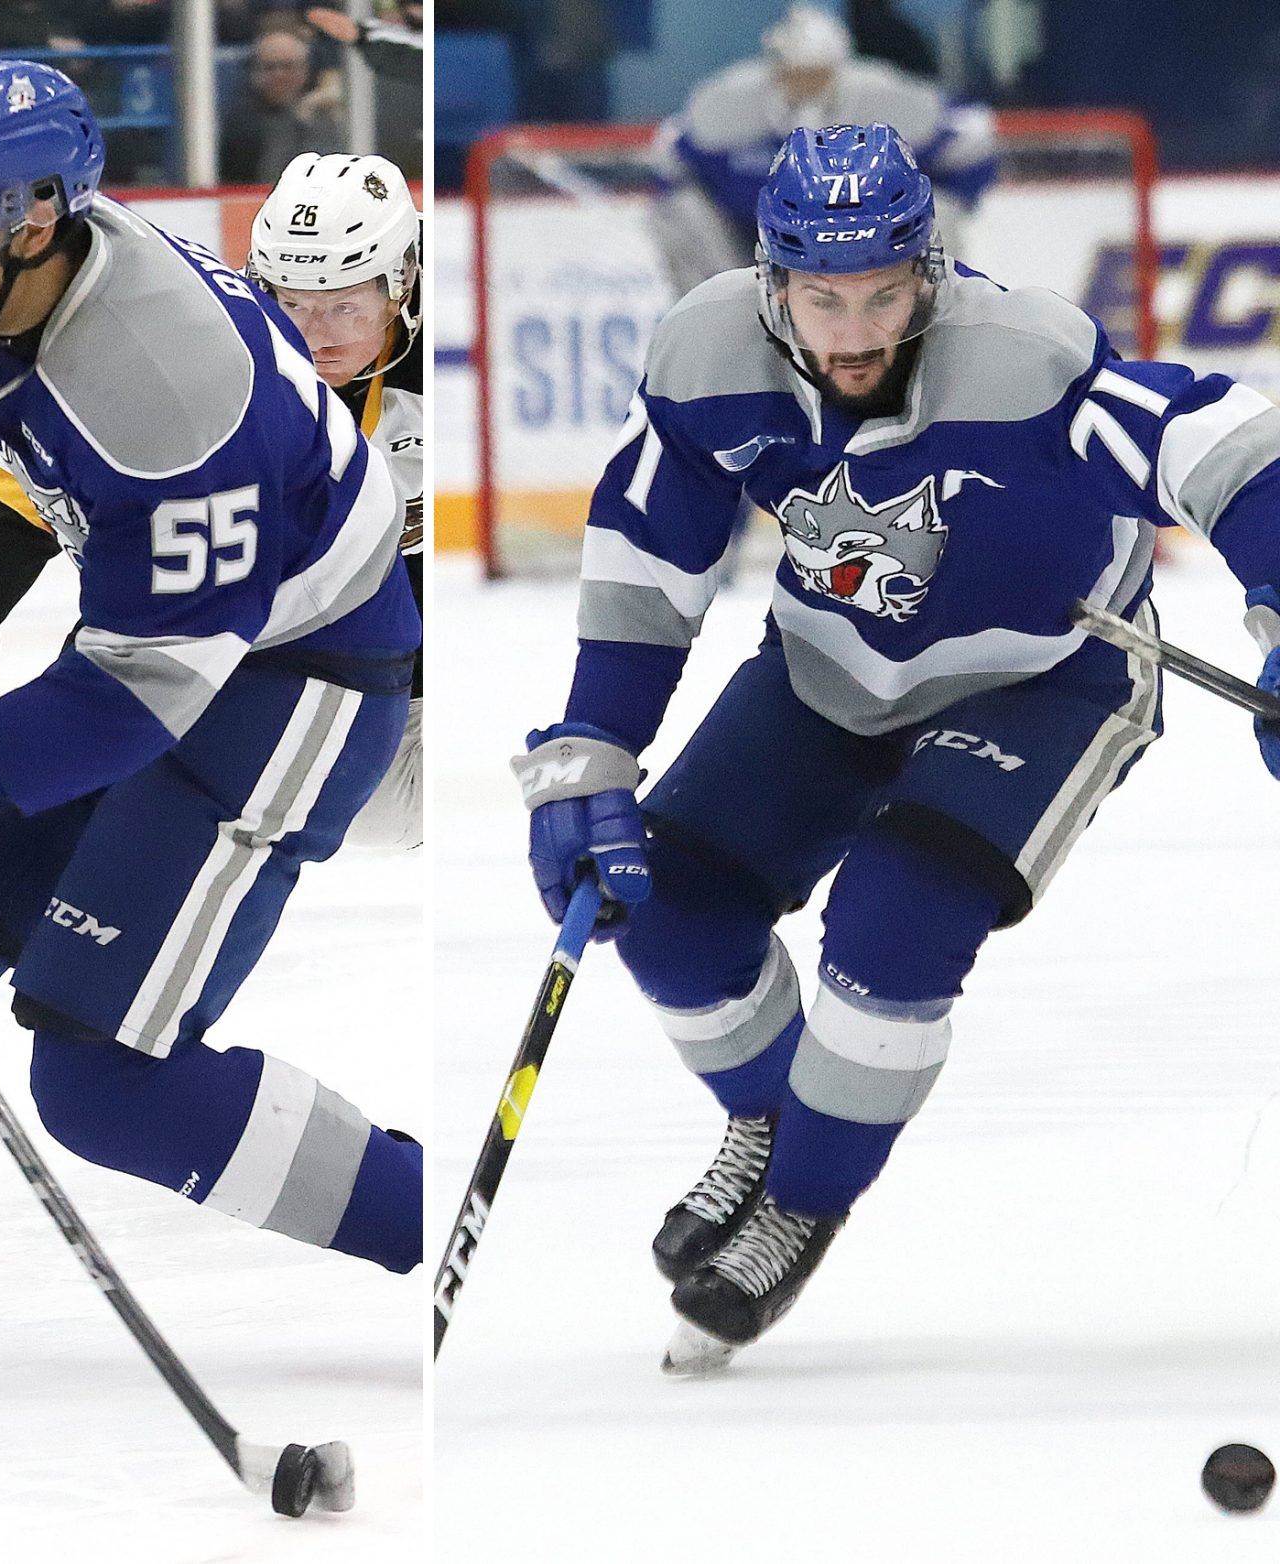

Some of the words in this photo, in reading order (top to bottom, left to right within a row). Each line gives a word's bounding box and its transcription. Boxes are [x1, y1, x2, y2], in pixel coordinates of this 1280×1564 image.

[821, 173, 861, 205] 71
[290, 204, 319, 227] 26
[815, 228, 877, 243] CCM
[279, 253, 328, 265] CCM
[1070, 367, 1172, 491] 71
[150, 483, 260, 594] 55
[911, 729, 1027, 772] CCM
[826, 962, 871, 996] CCM
[434, 1191, 490, 1322] CCM
